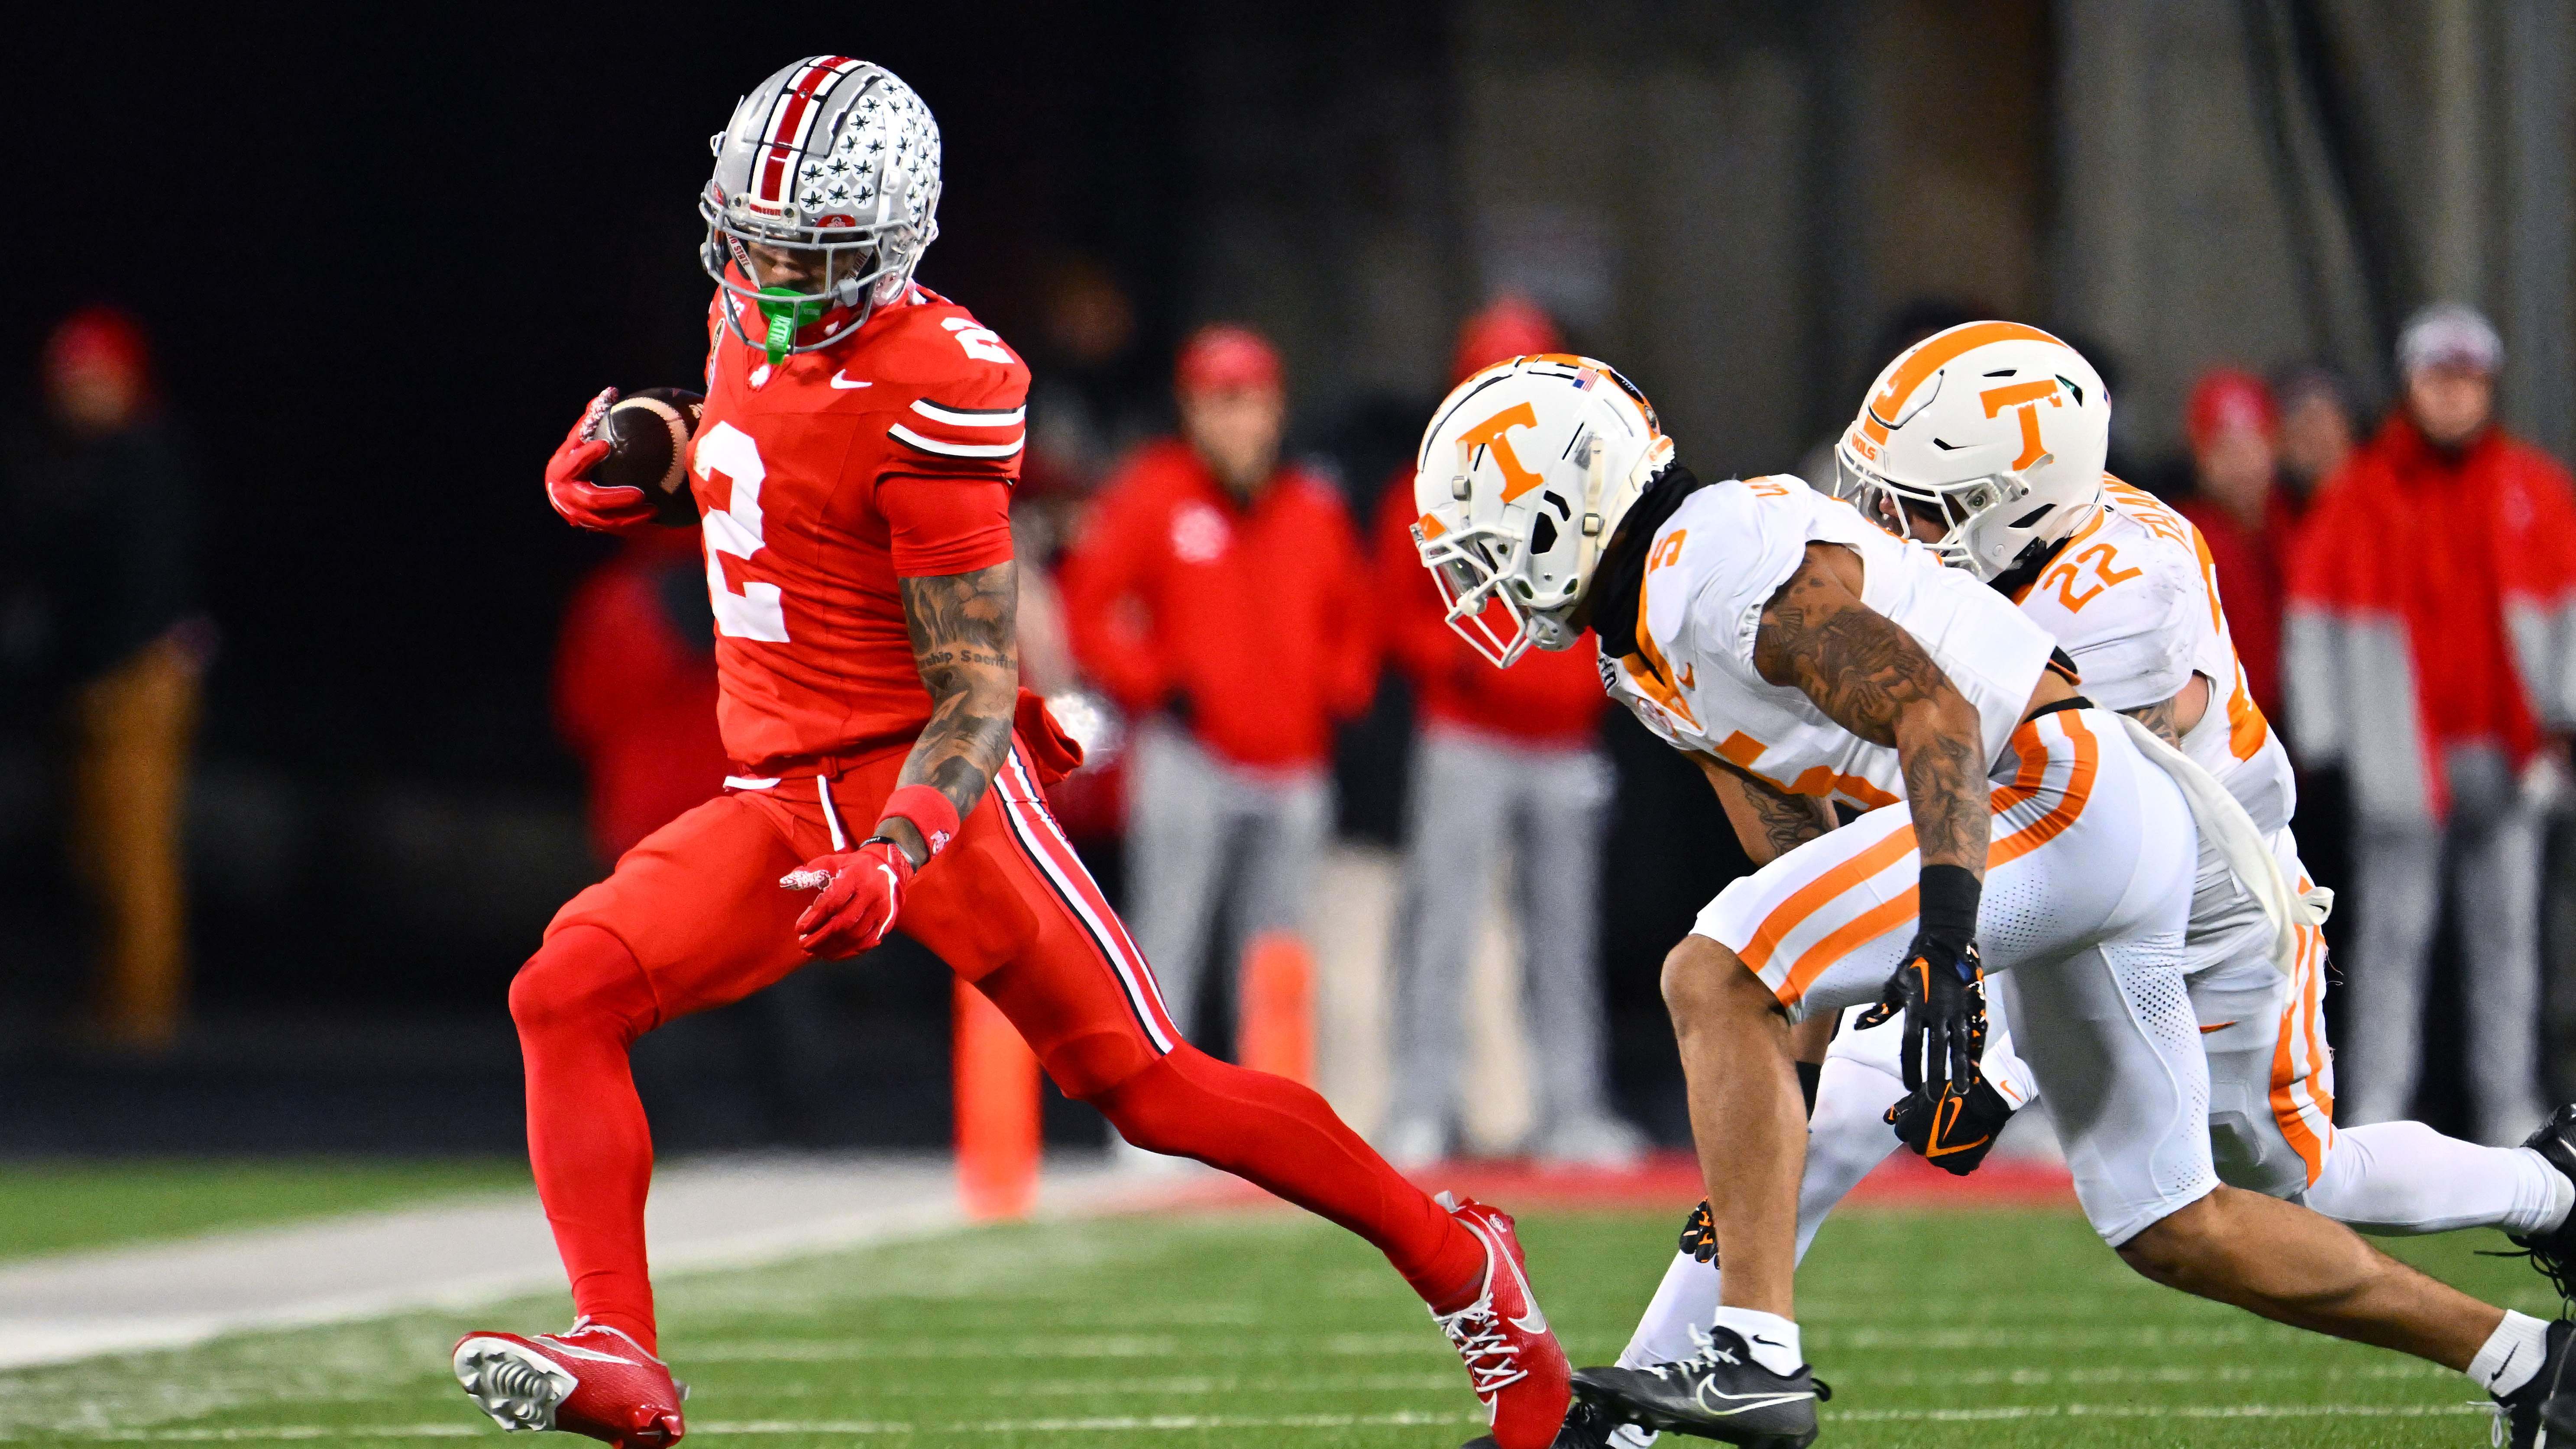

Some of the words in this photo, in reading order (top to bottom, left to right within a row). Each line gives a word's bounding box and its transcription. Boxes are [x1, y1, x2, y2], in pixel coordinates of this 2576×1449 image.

[941, 317, 1015, 364] 2
[1456, 401, 1544, 504] T
[1852, 433, 1877, 461] VOLS
[1979, 379, 2062, 471] T
[694, 420, 791, 643] 2
[1649, 528, 1687, 574] 5
[2042, 543, 2143, 614] 22
